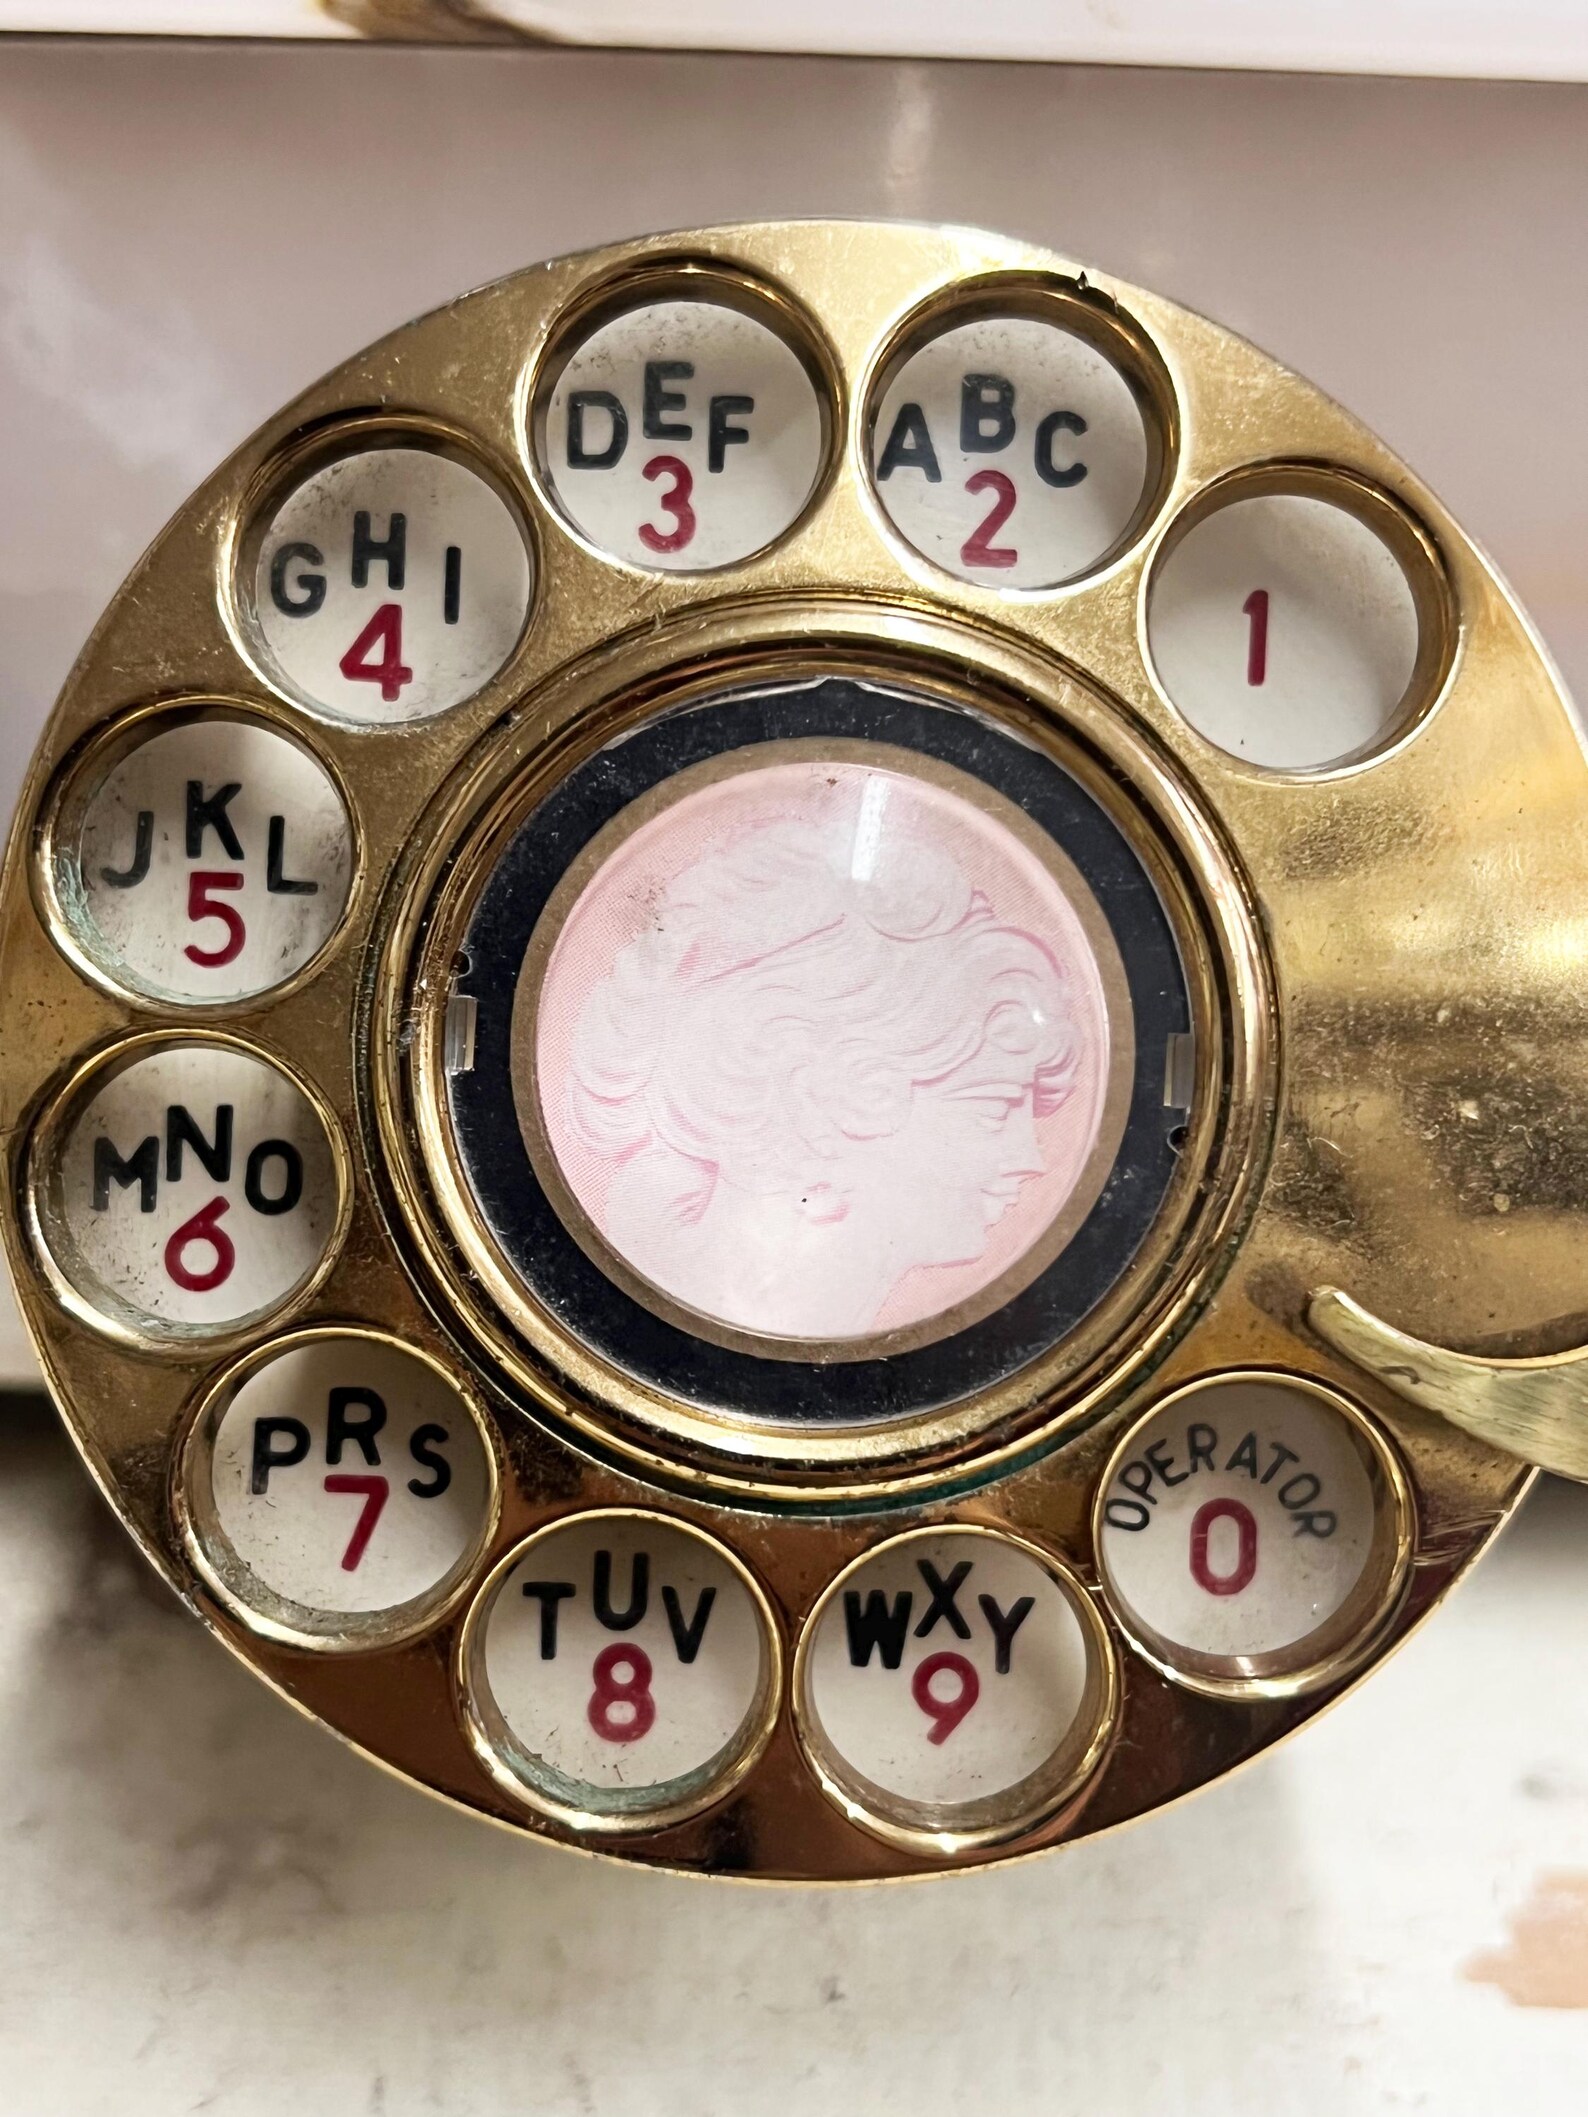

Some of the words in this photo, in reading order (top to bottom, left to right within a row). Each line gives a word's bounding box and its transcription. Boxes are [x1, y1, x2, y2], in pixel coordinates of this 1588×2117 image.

[566, 361, 754, 475] DEF
[876, 374, 1088, 488] ABC
[638, 455, 696, 554] 3
[960, 470, 1018, 568] 2
[270, 511, 462, 624] GHI
[339, 604, 413, 701] 4
[1242, 589, 1269, 686] 1
[101, 780, 318, 895] JKL
[183, 872, 246, 968] 5
[90, 1104, 303, 1216] MNO
[164, 1196, 236, 1292] 6
[251, 1387, 452, 1499] PRS
[1105, 1423, 1337, 1538] OPERATOR
[324, 1475, 390, 1572] 7
[1189, 1498, 1257, 1597] 0
[523, 1549, 717, 1664] TUV
[843, 1559, 1036, 1674] WXY
[588, 1642, 656, 1743] 8
[911, 1651, 980, 1746] 9
